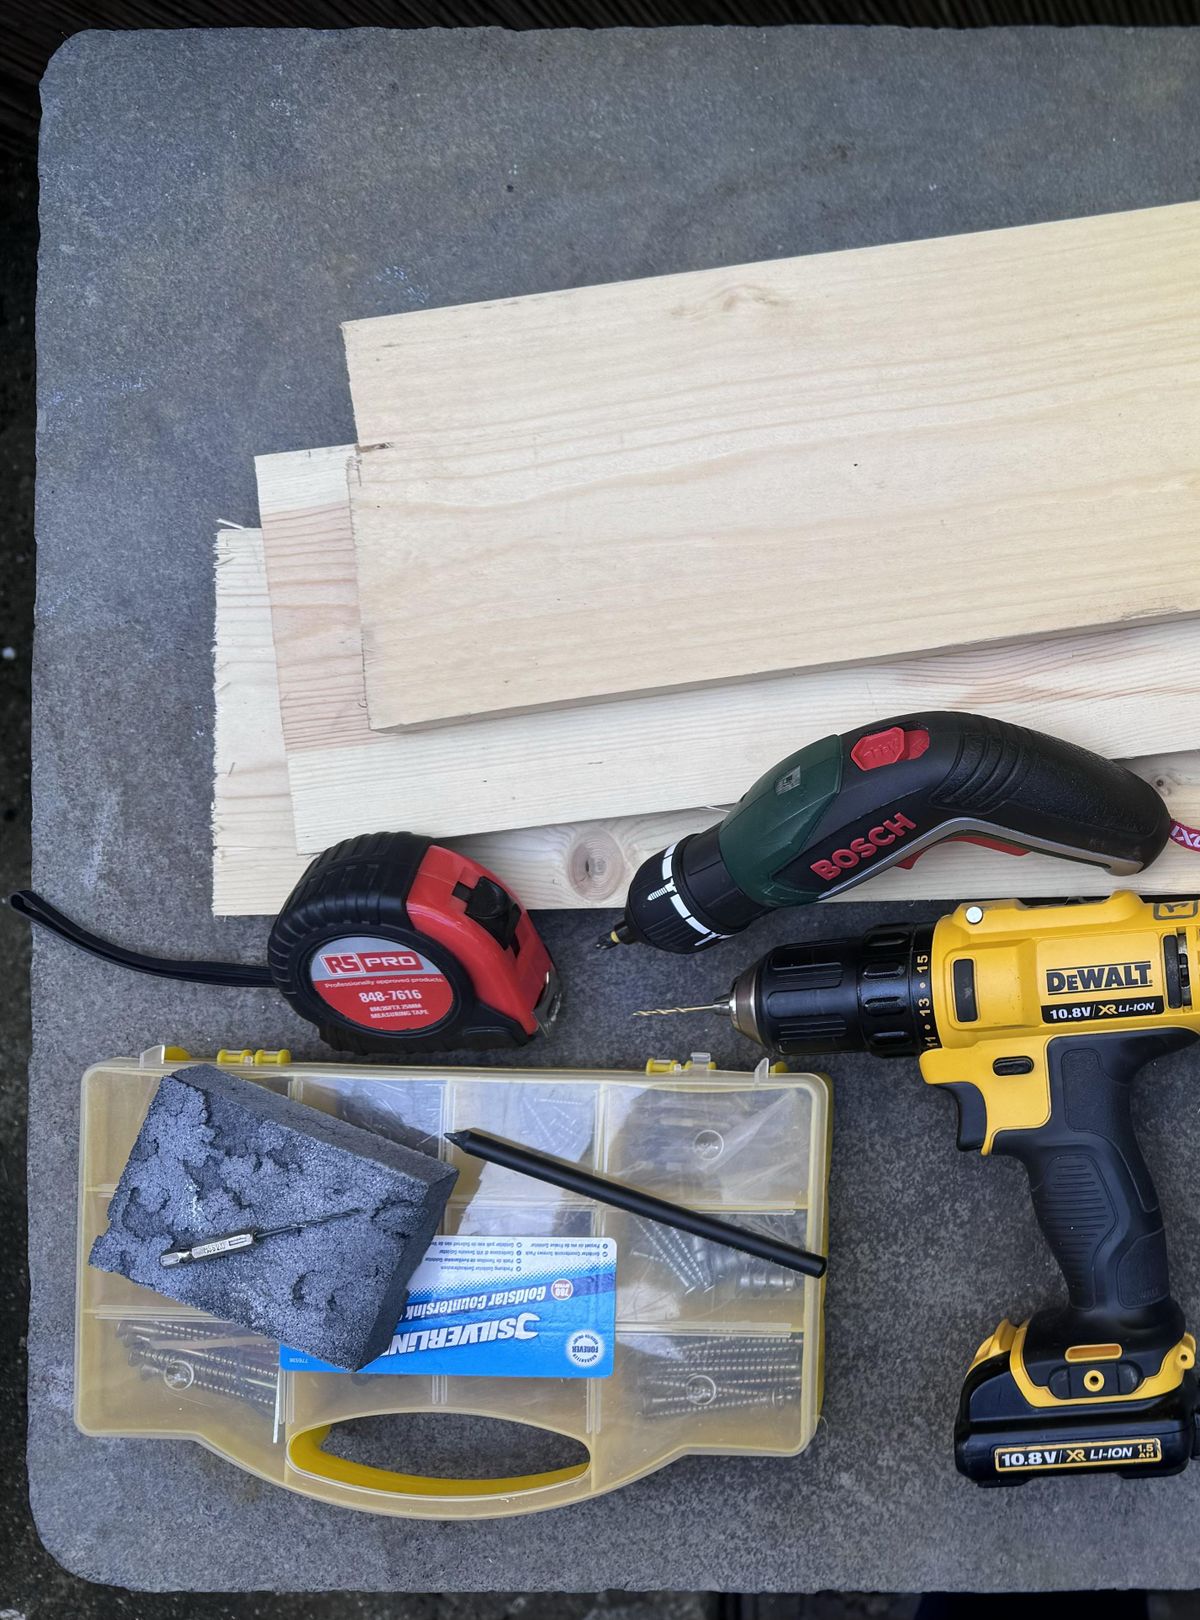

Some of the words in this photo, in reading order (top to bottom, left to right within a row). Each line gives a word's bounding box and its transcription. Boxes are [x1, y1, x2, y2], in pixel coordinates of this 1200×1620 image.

[809, 812, 917, 880] BOSCH
[322, 955, 361, 974] RS
[364, 955, 417, 968] PRO
[917, 954, 929, 973] 15
[324, 979, 375, 989] Professionally
[376, 977, 410, 985] approved
[1046, 962, 1154, 993] DEWALT
[358, 989, 422, 1004] 848-7616
[918, 997, 930, 1016] 13
[1098, 1004, 1118, 1016] XR
[1119, 1001, 1155, 1014] LI-ION
[488, 1286, 547, 1307] Goldstar
[405, 1294, 486, 1319] Countersink
[572, 1346, 599, 1354] FOREVER
[1066, 1449, 1086, 1463] XR
[1090, 1447, 1133, 1459] LI-ION
[1137, 1444, 1154, 1452] 1.5
